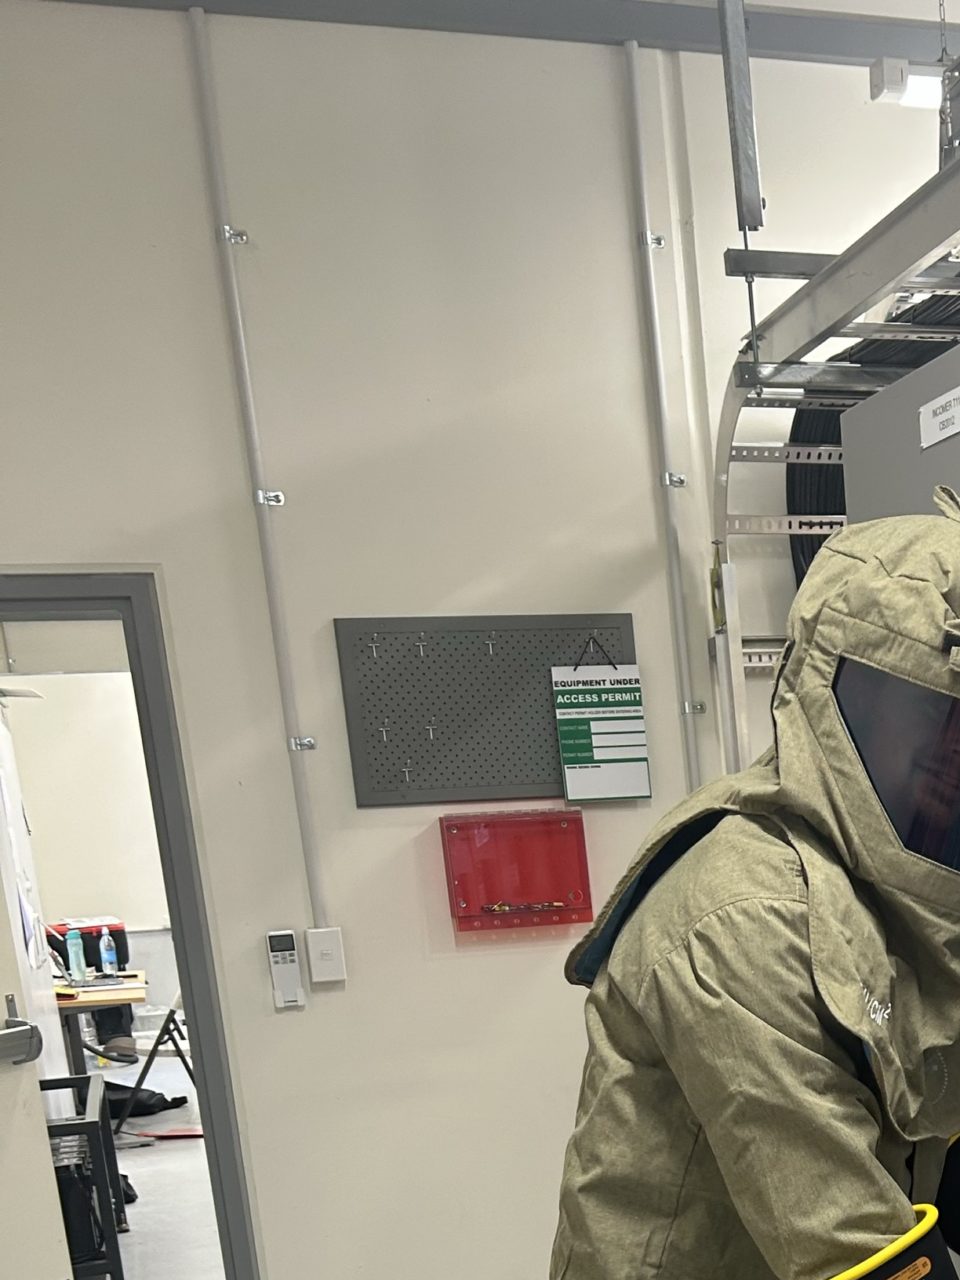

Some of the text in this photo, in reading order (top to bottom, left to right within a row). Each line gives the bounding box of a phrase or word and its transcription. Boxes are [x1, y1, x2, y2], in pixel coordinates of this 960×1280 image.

[554, 678, 640, 688] EQUIPMENT UNDER
[556, 692, 641, 704] ACCESS PERMIT
